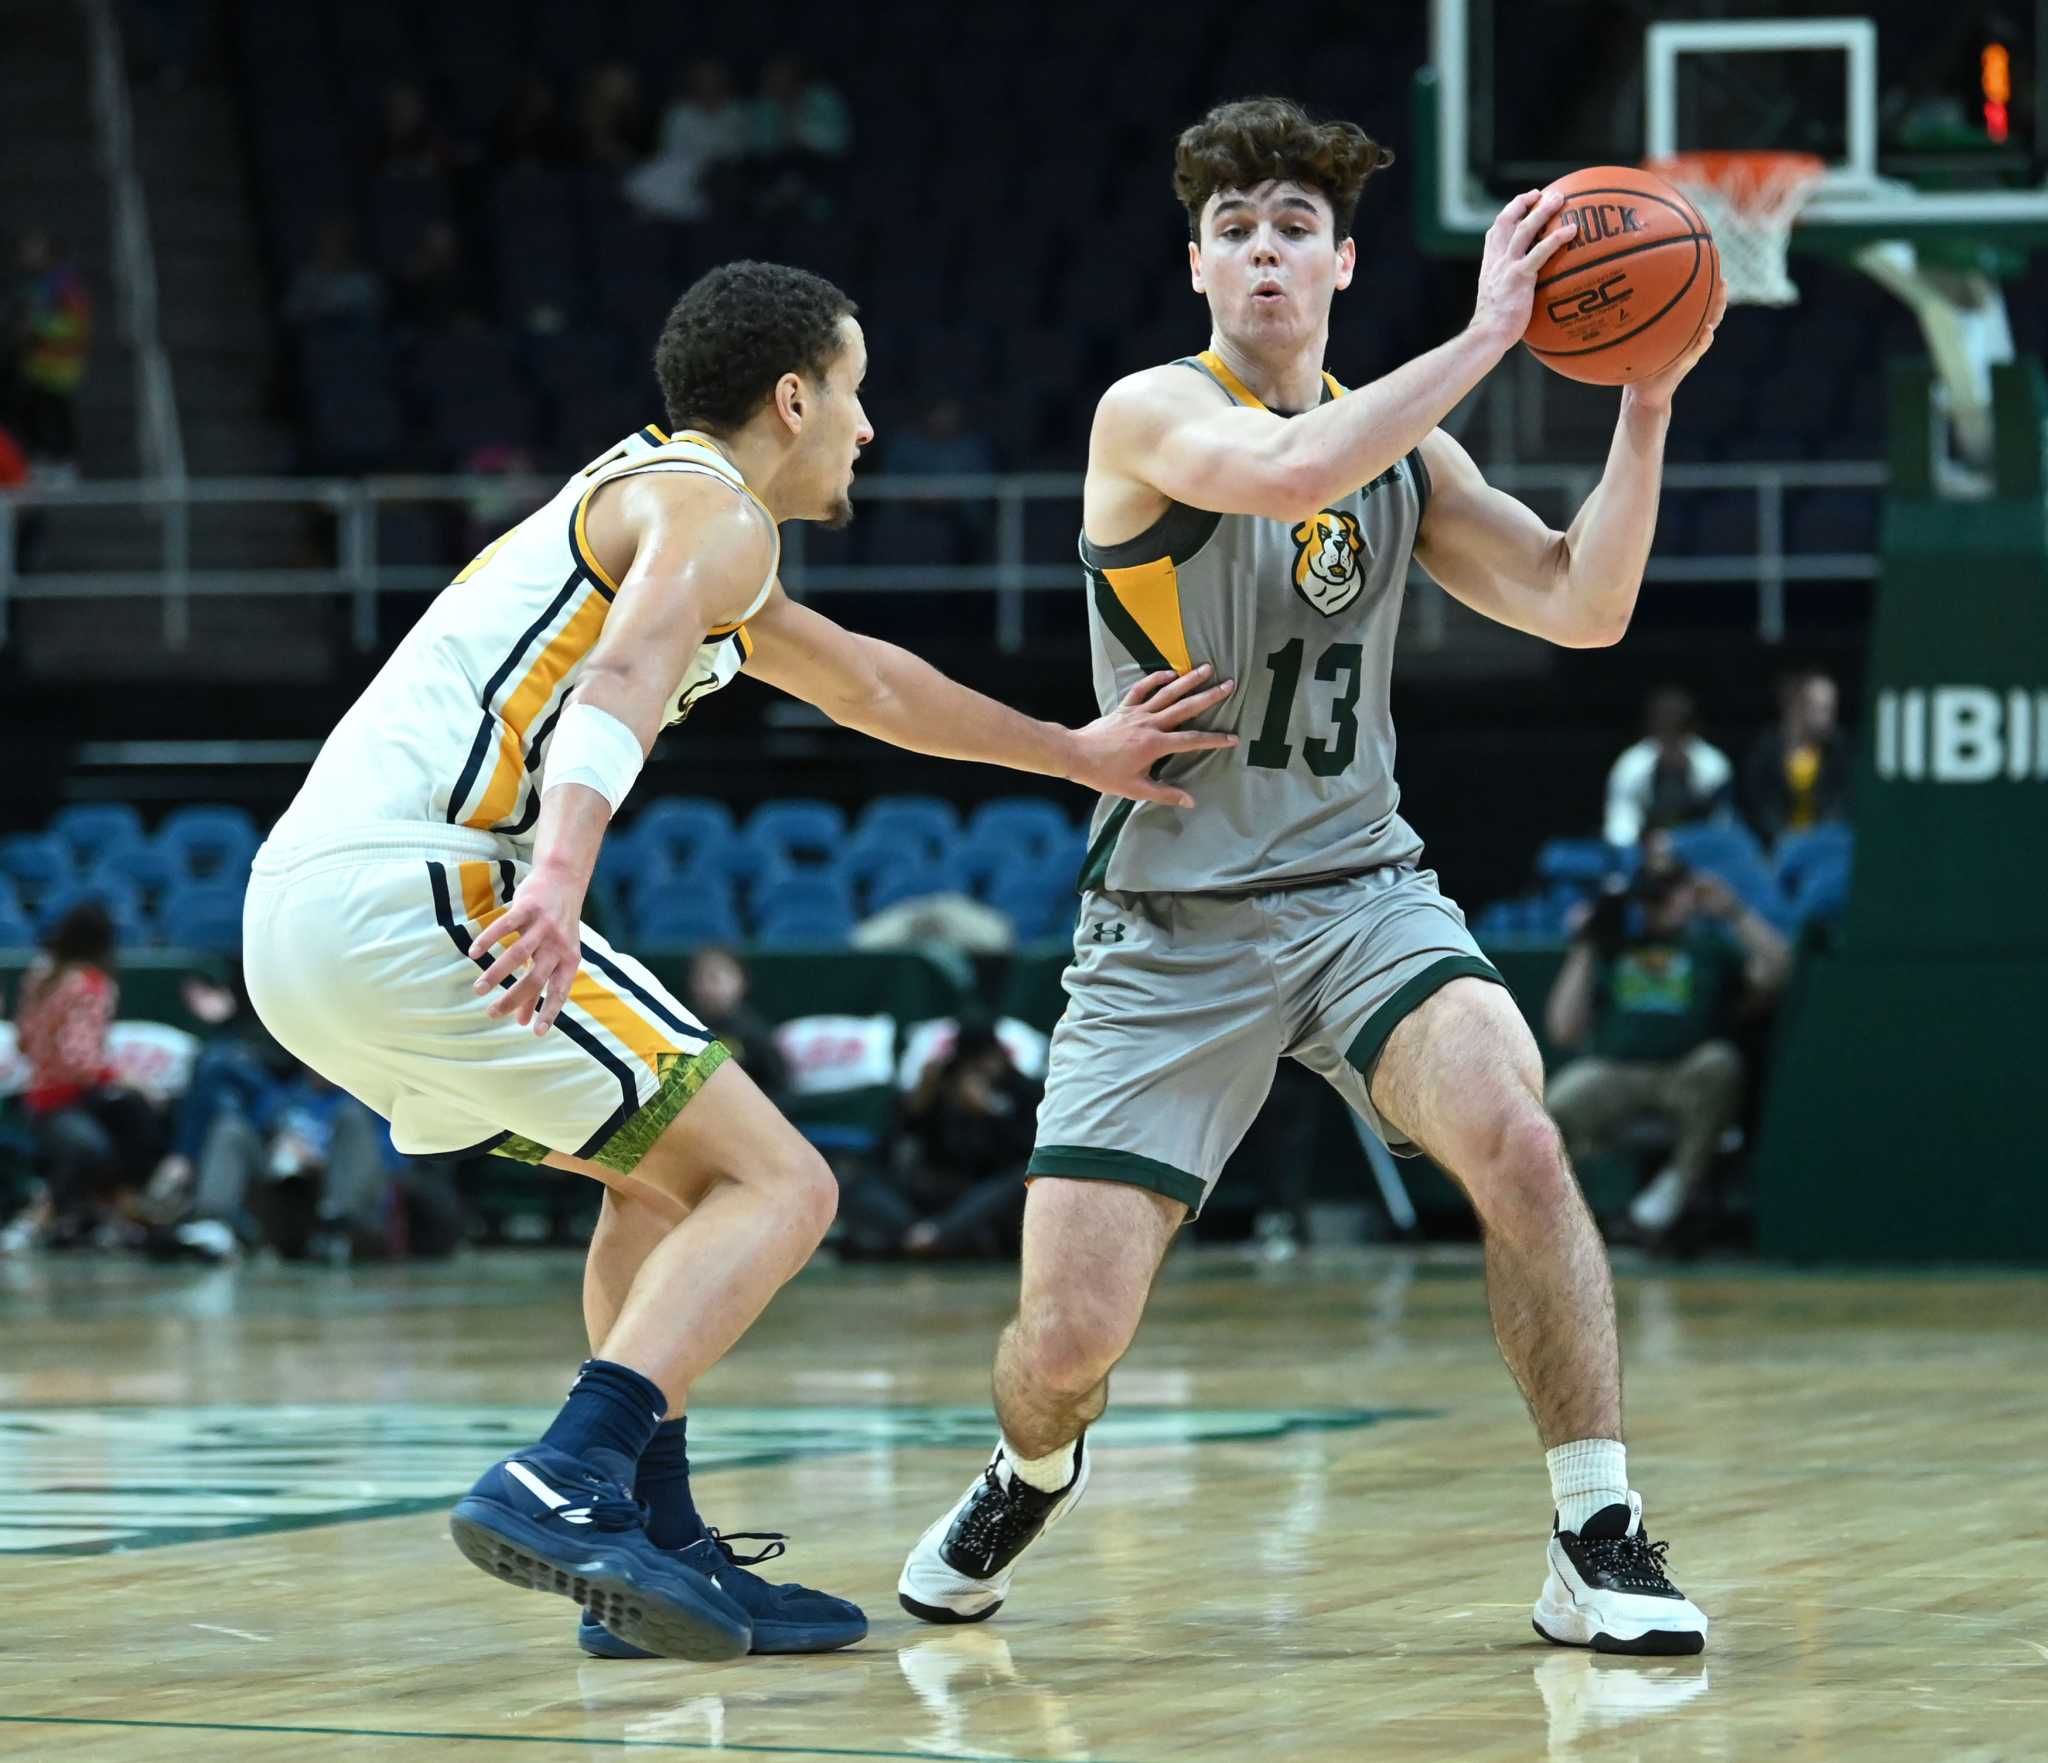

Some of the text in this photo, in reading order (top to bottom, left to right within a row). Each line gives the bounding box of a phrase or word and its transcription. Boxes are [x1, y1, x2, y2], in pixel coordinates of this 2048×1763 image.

[1561, 204, 1642, 250] ROCK
[1547, 273, 1634, 323] C2C
[1247, 637, 1363, 777] 13
